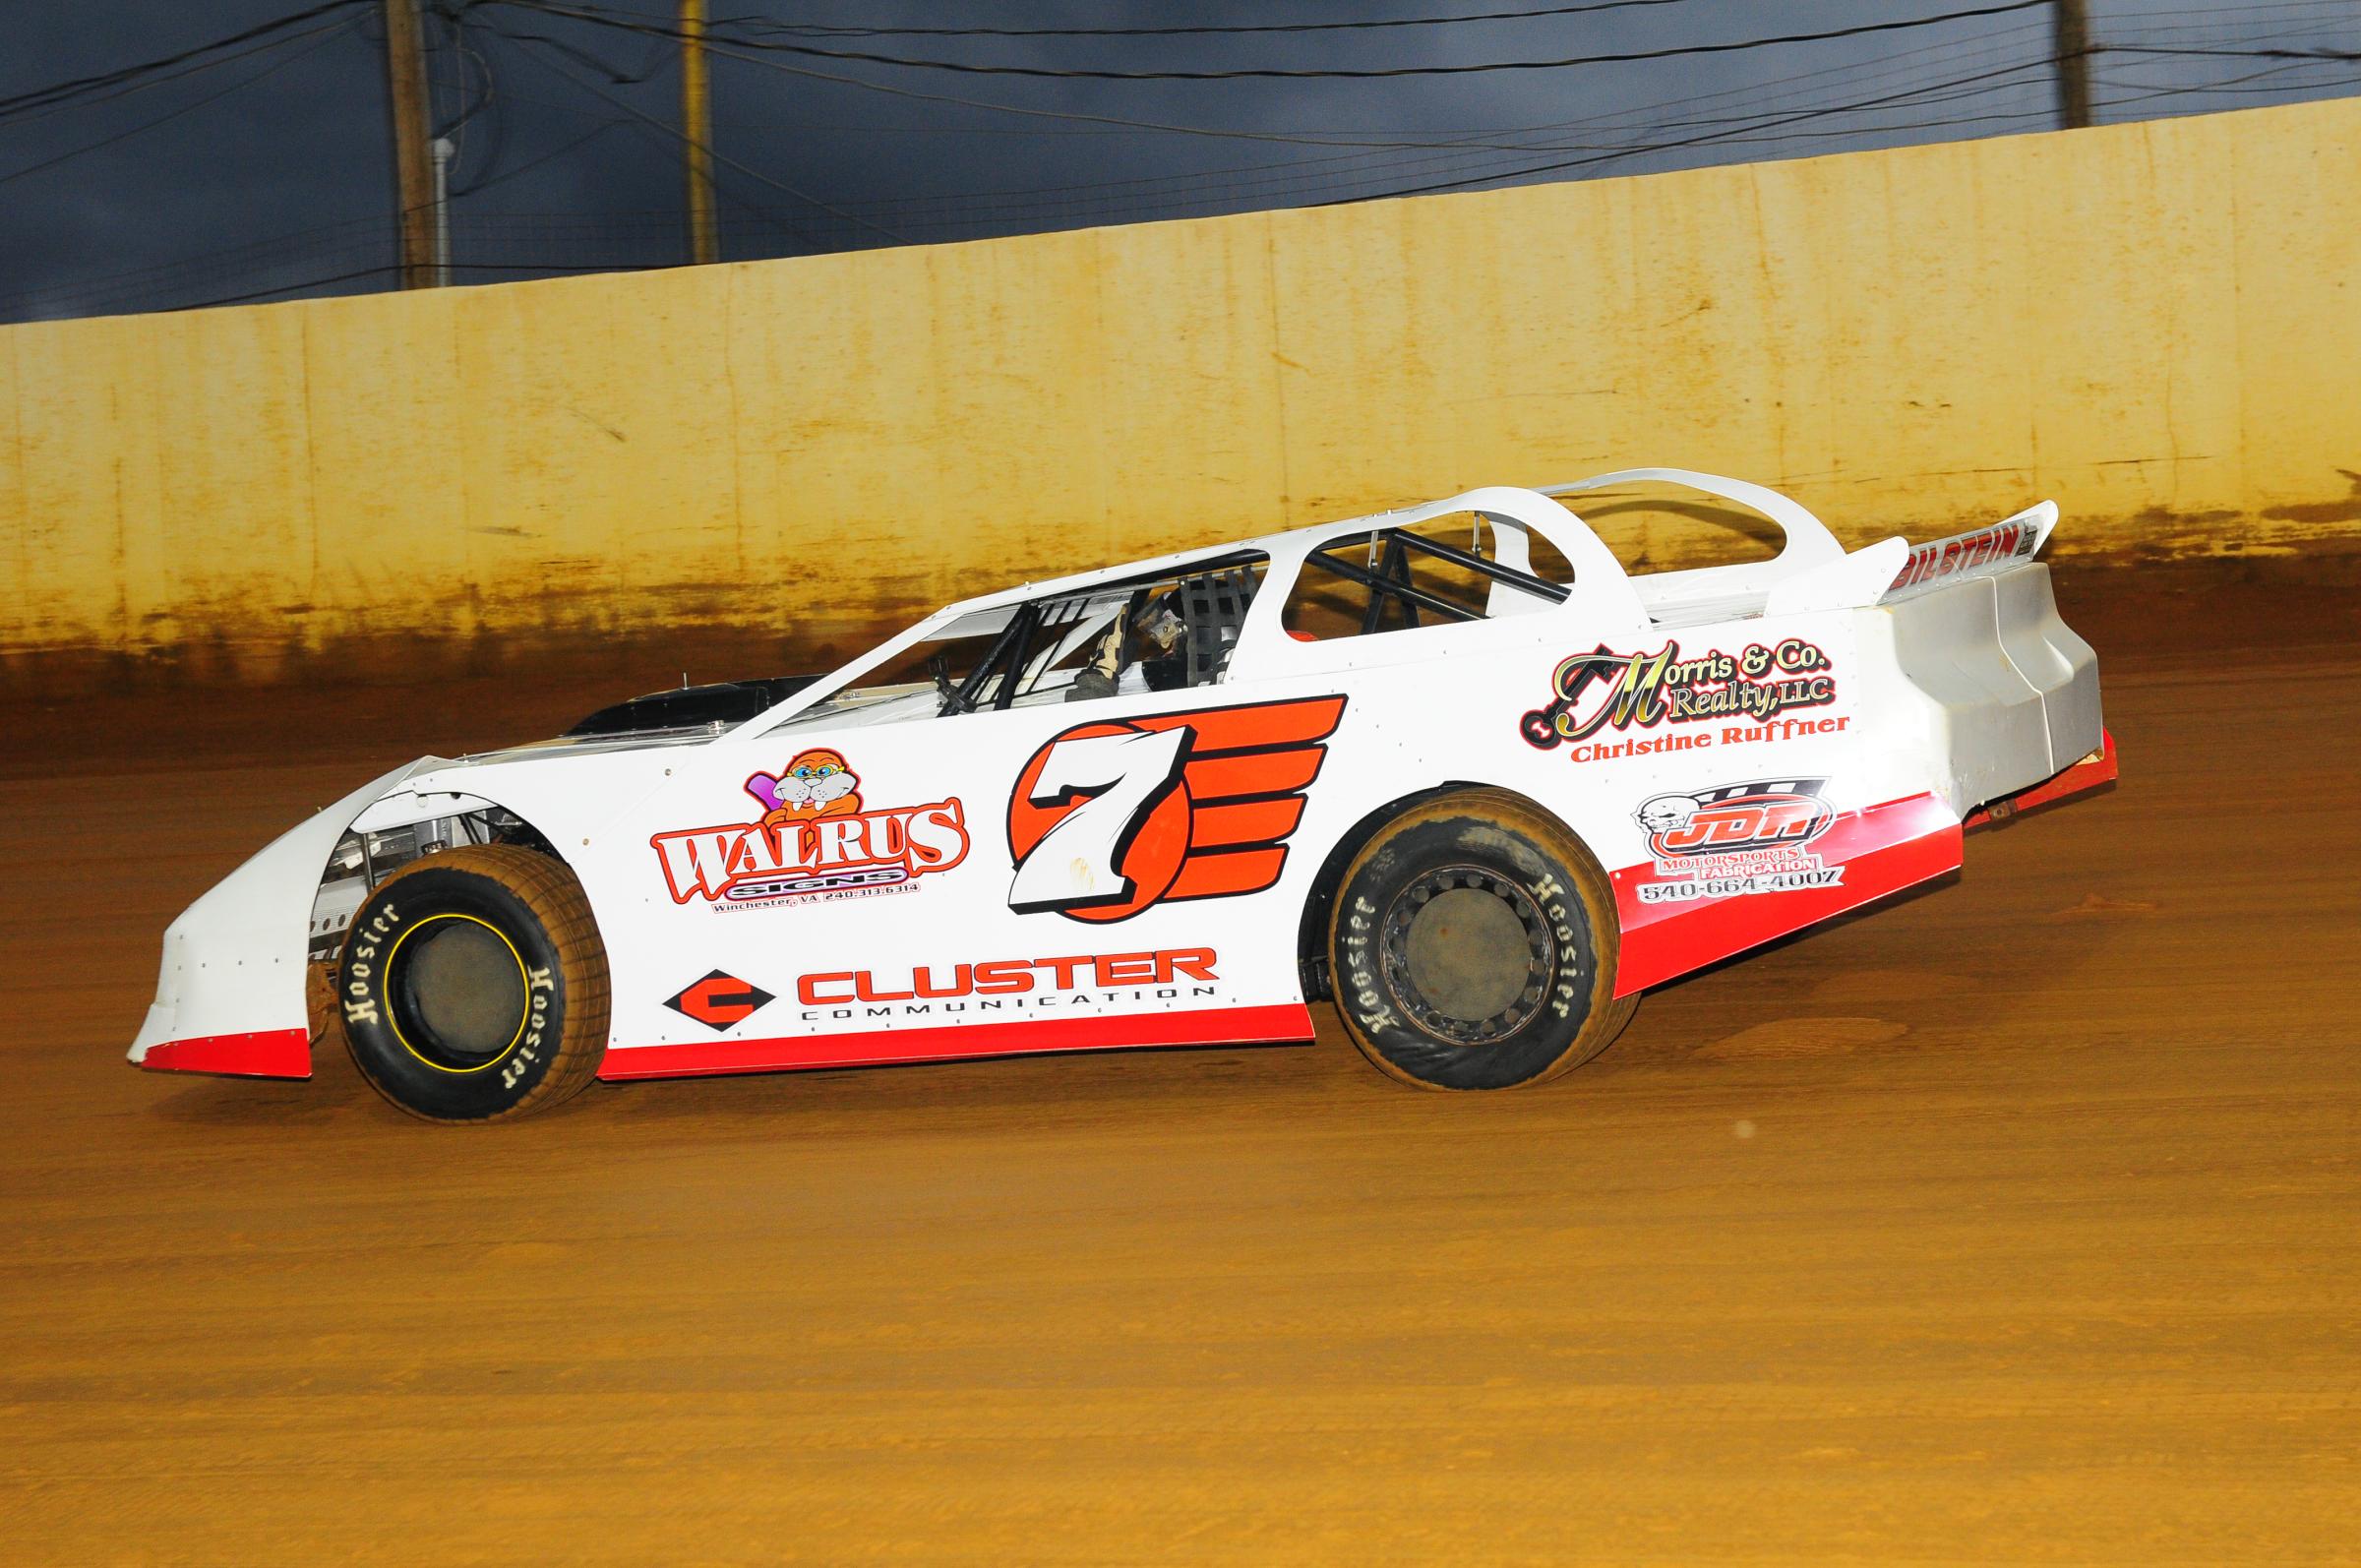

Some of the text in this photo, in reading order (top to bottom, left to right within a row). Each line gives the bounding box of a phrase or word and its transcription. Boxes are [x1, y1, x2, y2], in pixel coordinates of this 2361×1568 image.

[1889, 524, 2020, 590] BILSTEIN
[1554, 639, 1827, 738] Morris & Co.
[1570, 715, 1851, 763] Christine Ruffner
[649, 796, 971, 905] WALRUS
[1007, 723, 1198, 916] 7
[732, 872, 903, 896] SIGNS
[1643, 870, 1839, 901] 540-664-4007
[1663, 847, 1801, 872] MOTORSPORTS
[1699, 859, 1817, 880] FABRICATION
[713, 882, 920, 913] Winchester, VA 240.313.6314
[344, 903, 400, 1025] Hoosier
[796, 945, 1220, 1006] CLUSTER
[1341, 896, 1401, 1033] Hoosier
[1526, 873, 1584, 1018] Hoosier
[501, 964, 554, 1089] Hoosier
[801, 987, 1217, 1021] COMMUNICATION
